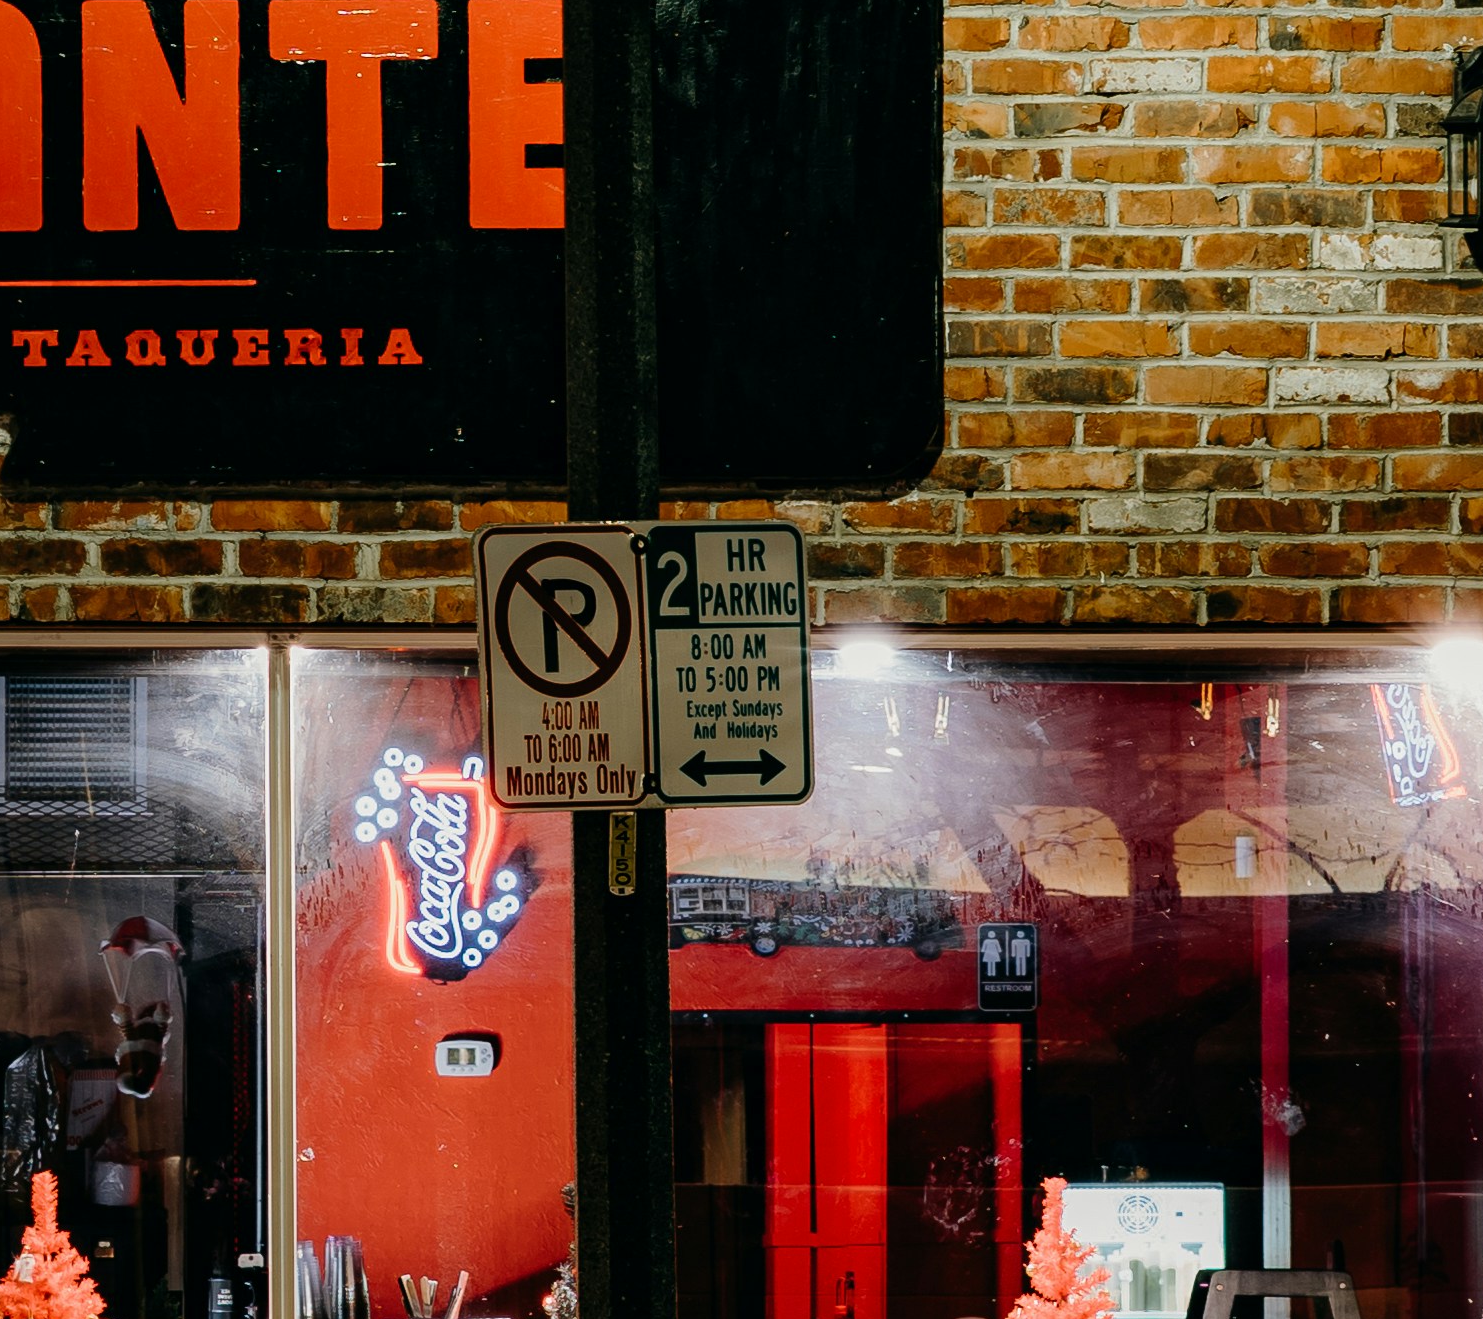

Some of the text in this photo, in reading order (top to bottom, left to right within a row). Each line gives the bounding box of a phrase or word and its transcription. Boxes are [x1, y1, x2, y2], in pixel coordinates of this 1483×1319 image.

[12, 327, 425, 368] TAQUERIA
[657, 538, 766, 617] 2 HR
[700, 582, 797, 616] PARKING
[691, 634, 766, 659] 8:00 AM
[676, 666, 780, 692] TO 5:00 PM
[542, 701, 599, 731] 4:00 AM
[687, 699, 783, 721] Except Sundays
[694, 721, 778, 741] And Holidays
[524, 733, 609, 763] TO 6:00 AM
[507, 764, 636, 800] Mondays Only
[984, 984, 1032, 992] RESTROOM
